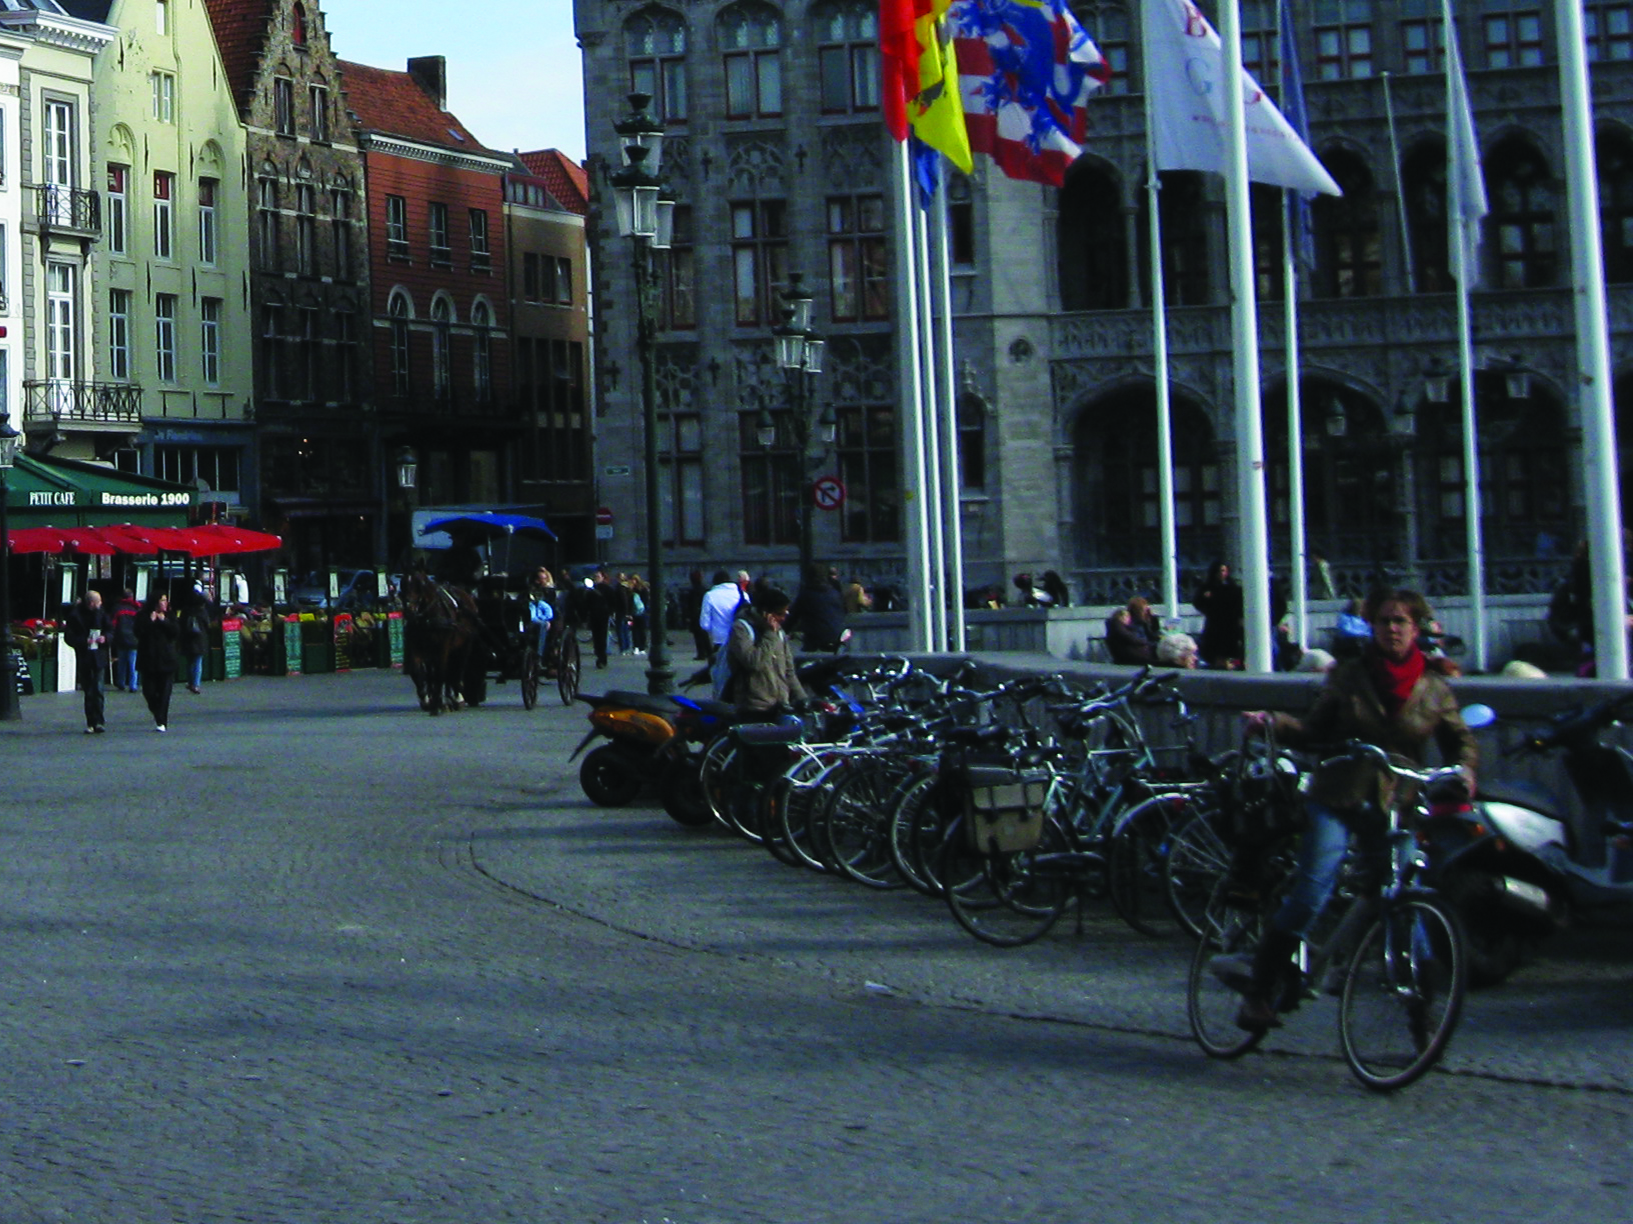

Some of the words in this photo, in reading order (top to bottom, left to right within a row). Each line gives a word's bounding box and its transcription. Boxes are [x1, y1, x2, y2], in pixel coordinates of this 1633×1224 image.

[29, 491, 53, 506] PETIT
[54, 491, 76, 506] CAFE
[101, 492, 158, 506] Brasserie
[160, 492, 191, 506] 1900
